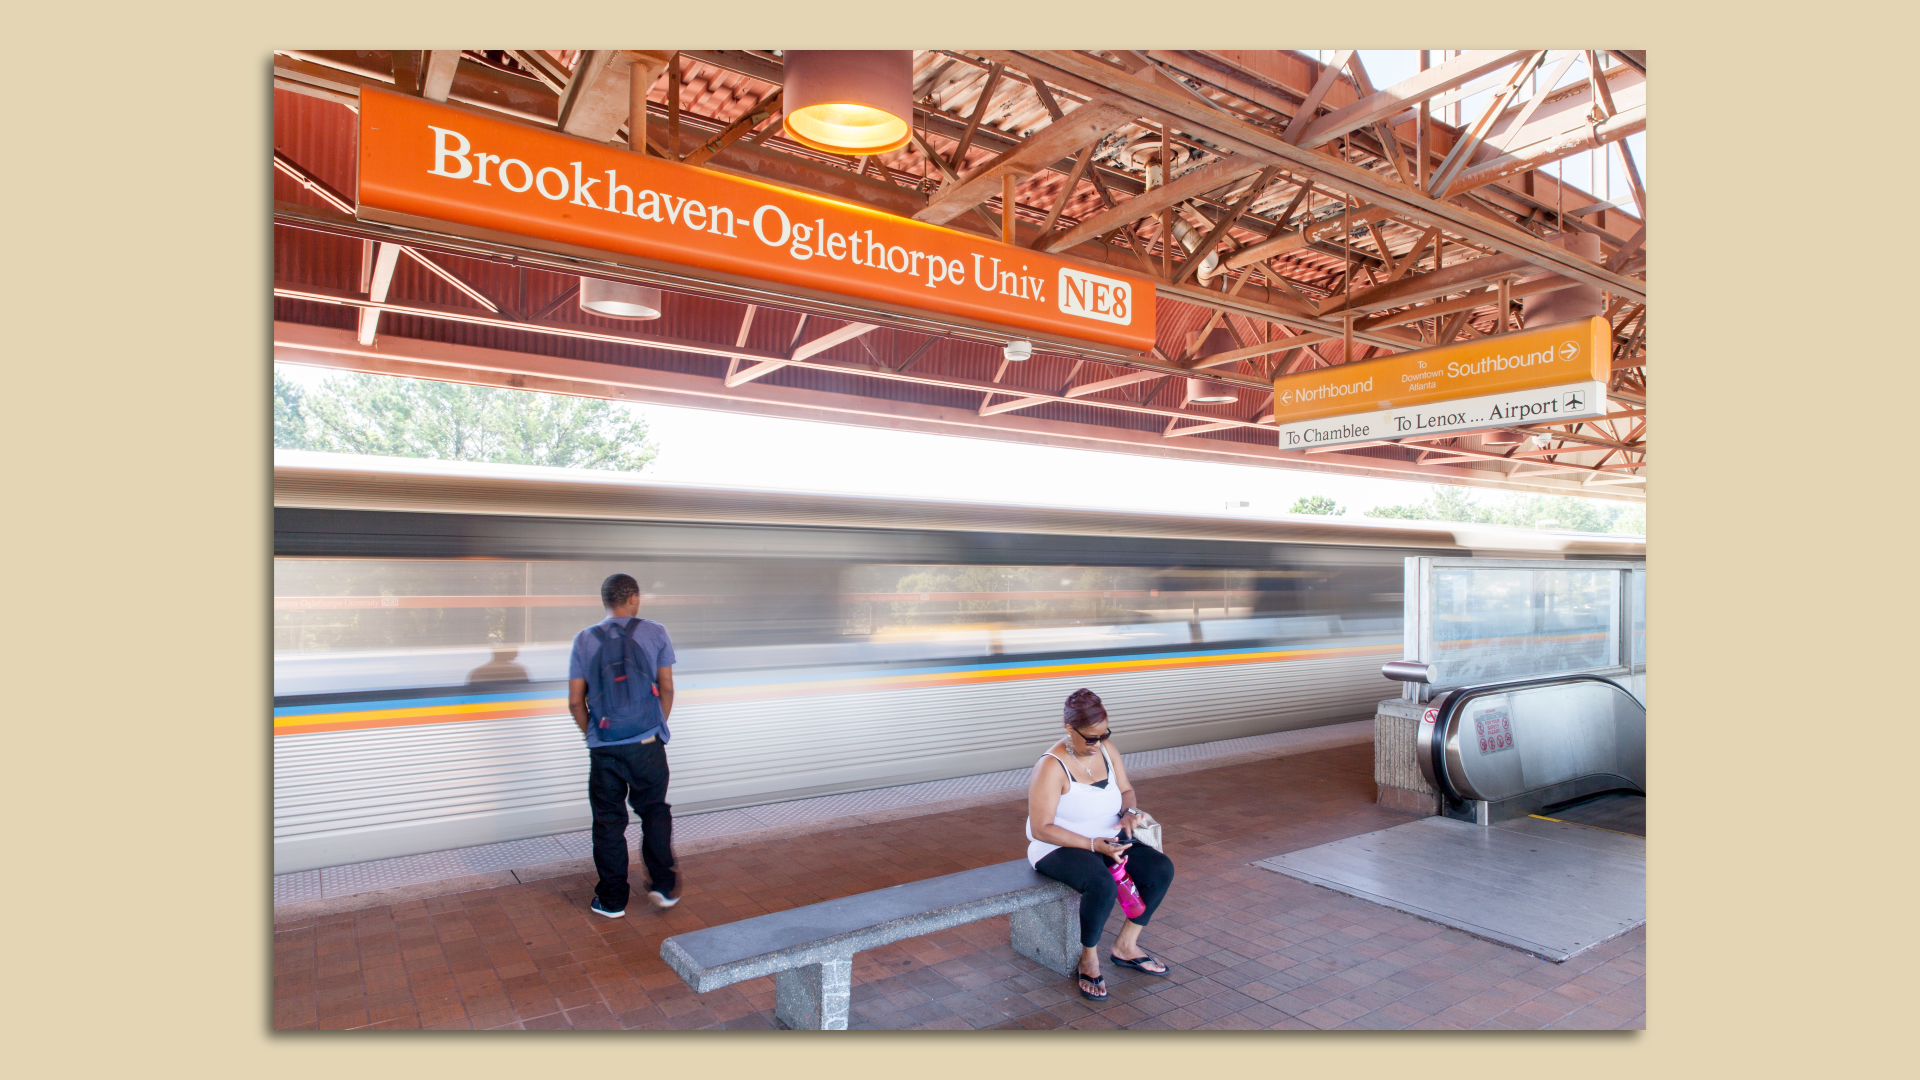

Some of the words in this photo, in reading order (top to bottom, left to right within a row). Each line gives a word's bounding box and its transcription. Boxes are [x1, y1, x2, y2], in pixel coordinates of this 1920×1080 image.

[427, 125, 965, 288] Brookhaven-Oglethorpe
[971, 252, 1045, 303] Univ.
[1063, 274, 1127, 319] NE8
[1417, 360, 1428, 369] To
[1447, 345, 1554, 378] Southbound
[1401, 369, 1444, 383] Downtown
[1408, 380, 1437, 392] Atlanta
[1295, 377, 1373, 403] Northbound
[1394, 416, 1412, 431] To
[1416, 412, 1466, 430] Lenox
[1488, 397, 1559, 420] Airport
[1286, 430, 1301, 445] To
[1303, 424, 1370, 443] Chamblee
[274, 599, 342, 609] haven-Oglethorpe
